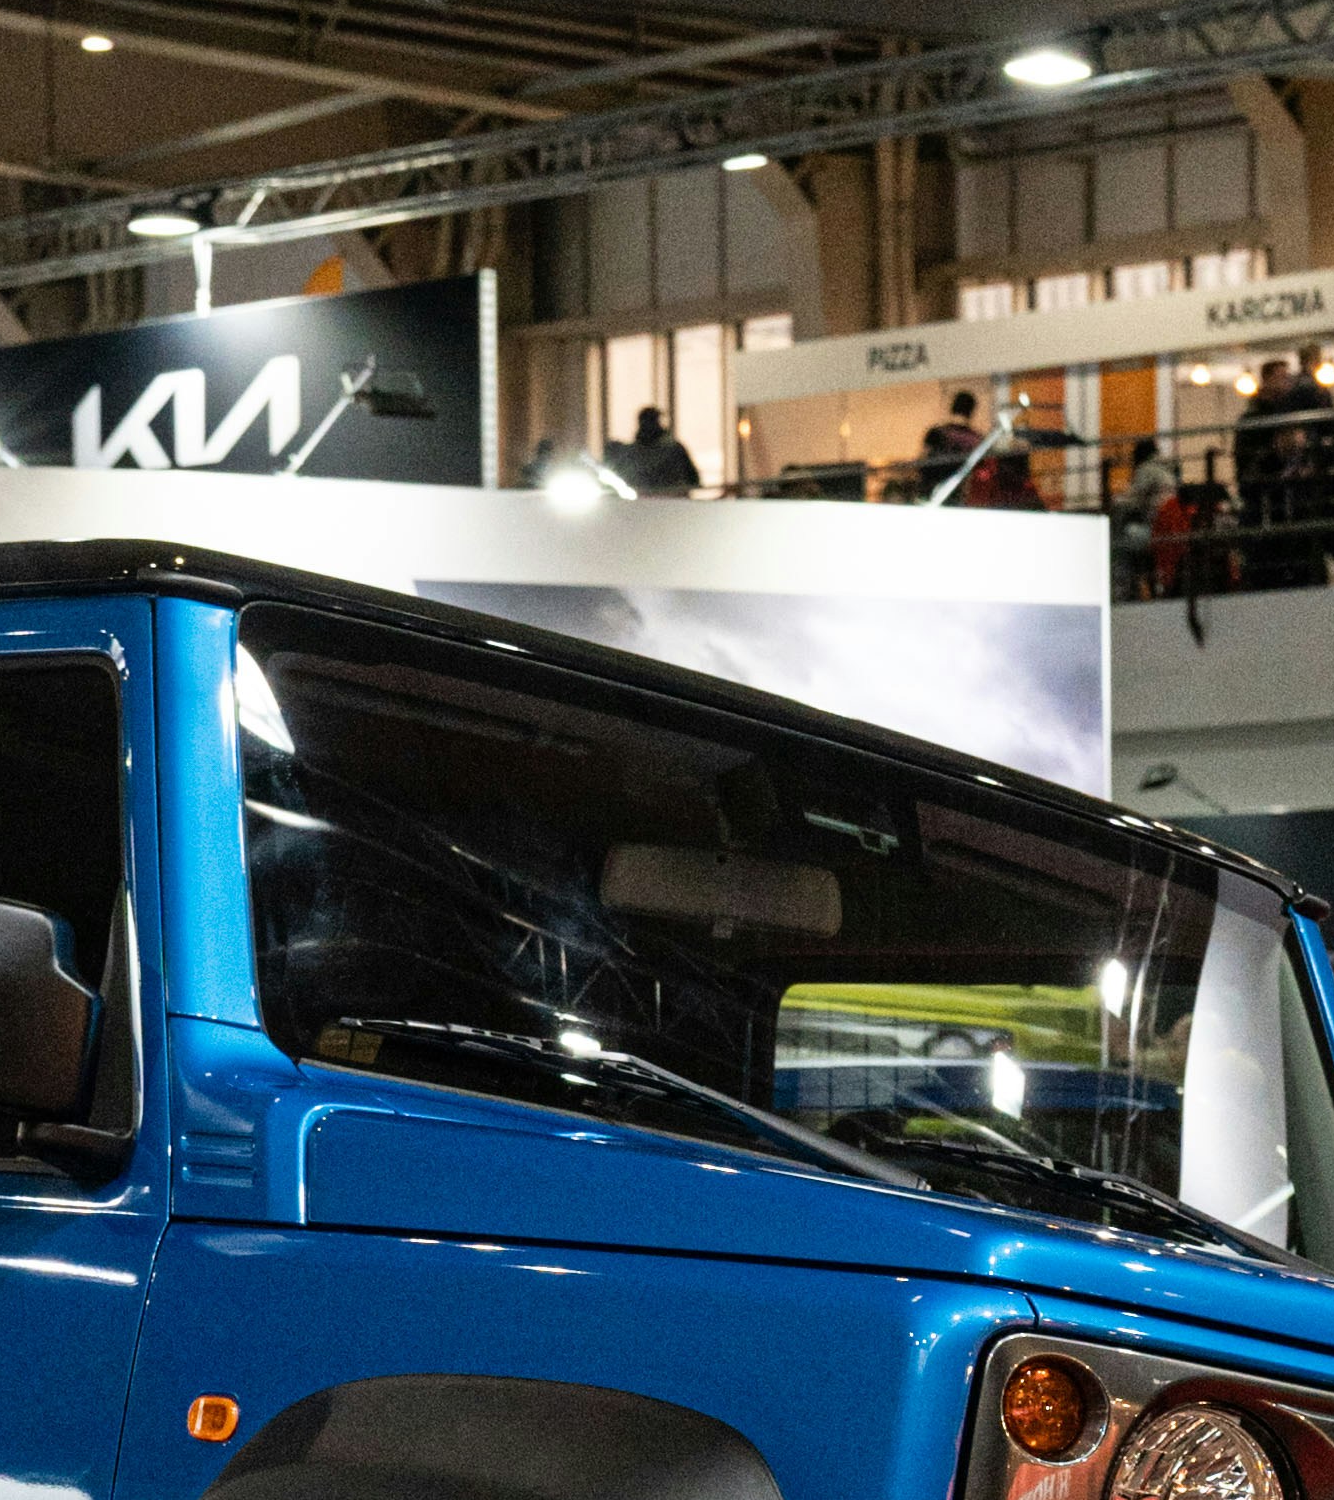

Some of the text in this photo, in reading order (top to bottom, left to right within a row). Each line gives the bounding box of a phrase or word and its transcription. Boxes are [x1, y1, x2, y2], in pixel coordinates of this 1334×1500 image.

[868, 289, 1326, 372] PIZZA KARCZMA
[72, 355, 302, 469] KIA
